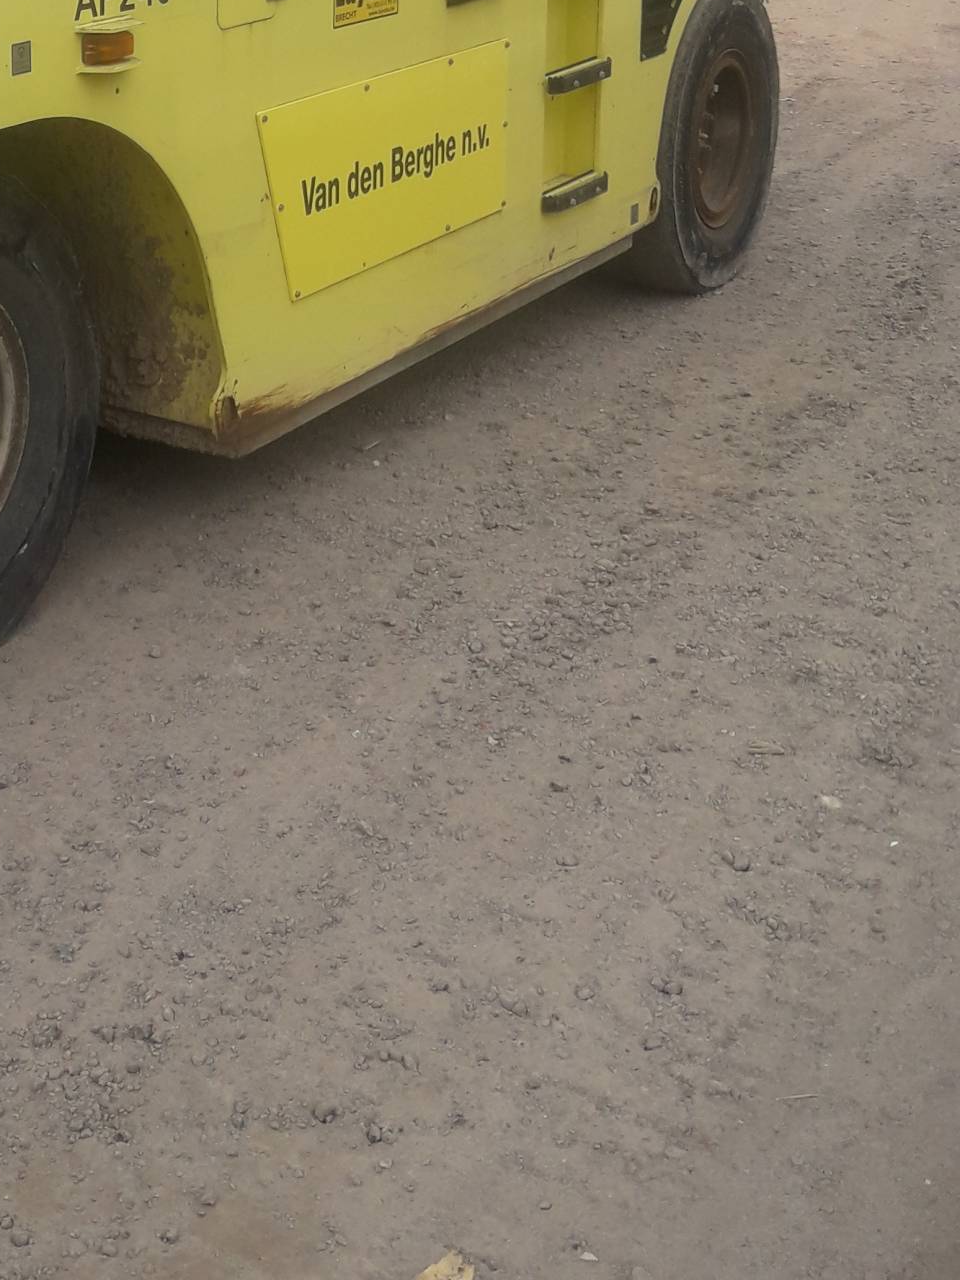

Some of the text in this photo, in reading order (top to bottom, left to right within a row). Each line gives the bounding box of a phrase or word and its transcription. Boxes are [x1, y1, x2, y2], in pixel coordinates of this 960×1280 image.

[301, 123, 490, 216] Van den Berghe n.v.
